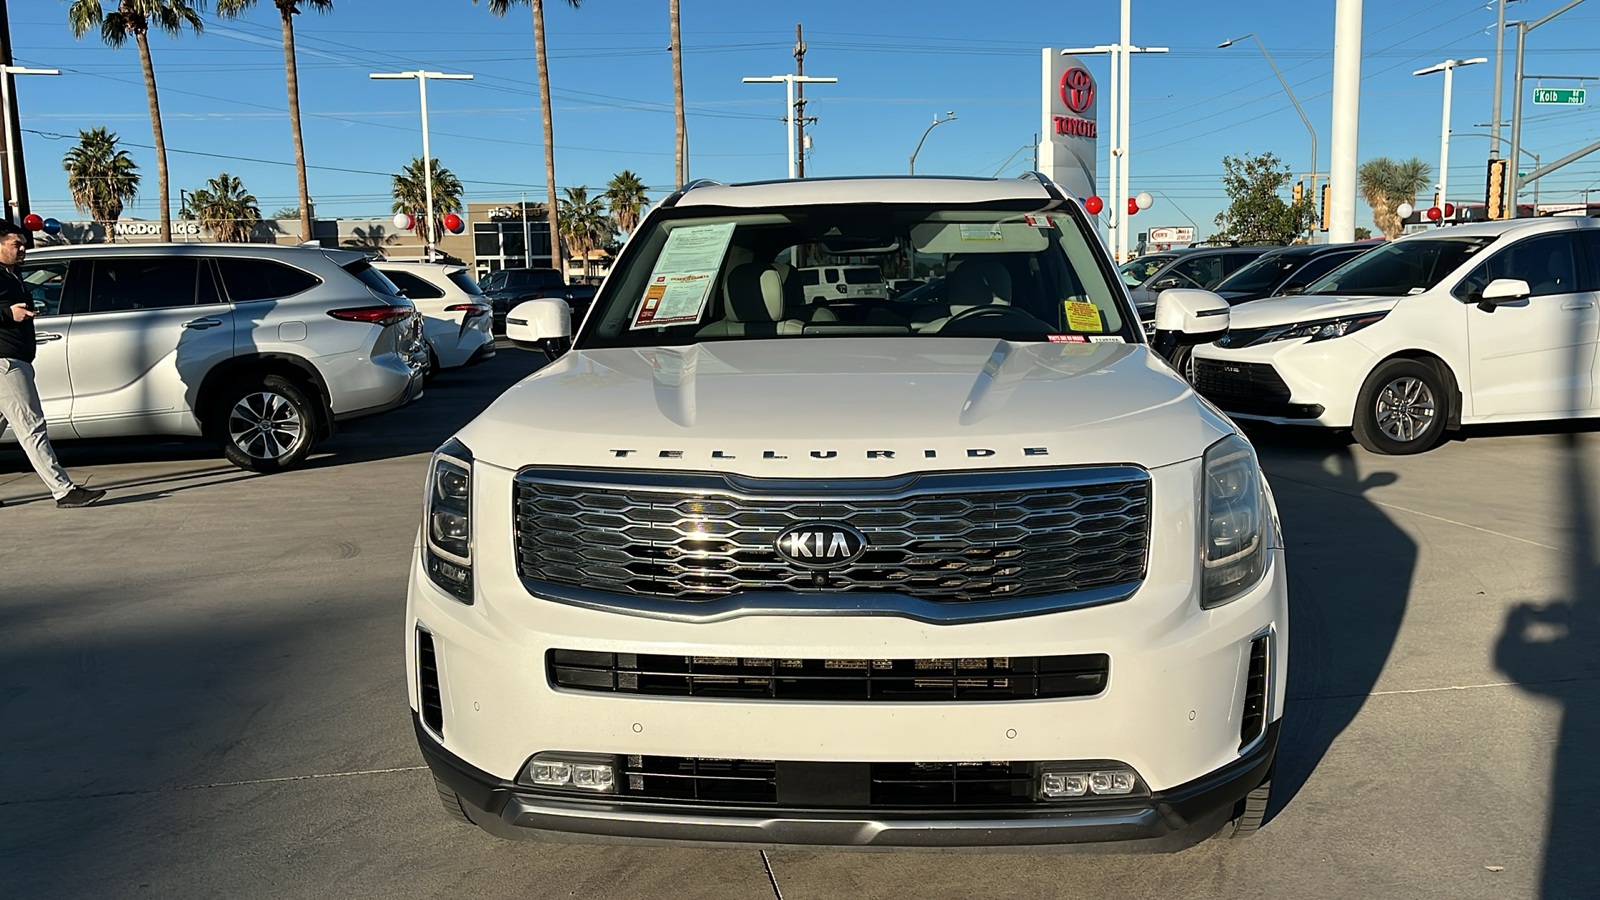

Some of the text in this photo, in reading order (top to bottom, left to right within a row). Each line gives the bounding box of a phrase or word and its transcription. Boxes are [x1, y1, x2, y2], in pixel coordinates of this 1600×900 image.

[1540, 91, 1558, 102] Kolb
[1053, 116, 1097, 138] TOYOTA
[609, 446, 1050, 460] TELLURIDE
[790, 532, 850, 558] KIA
